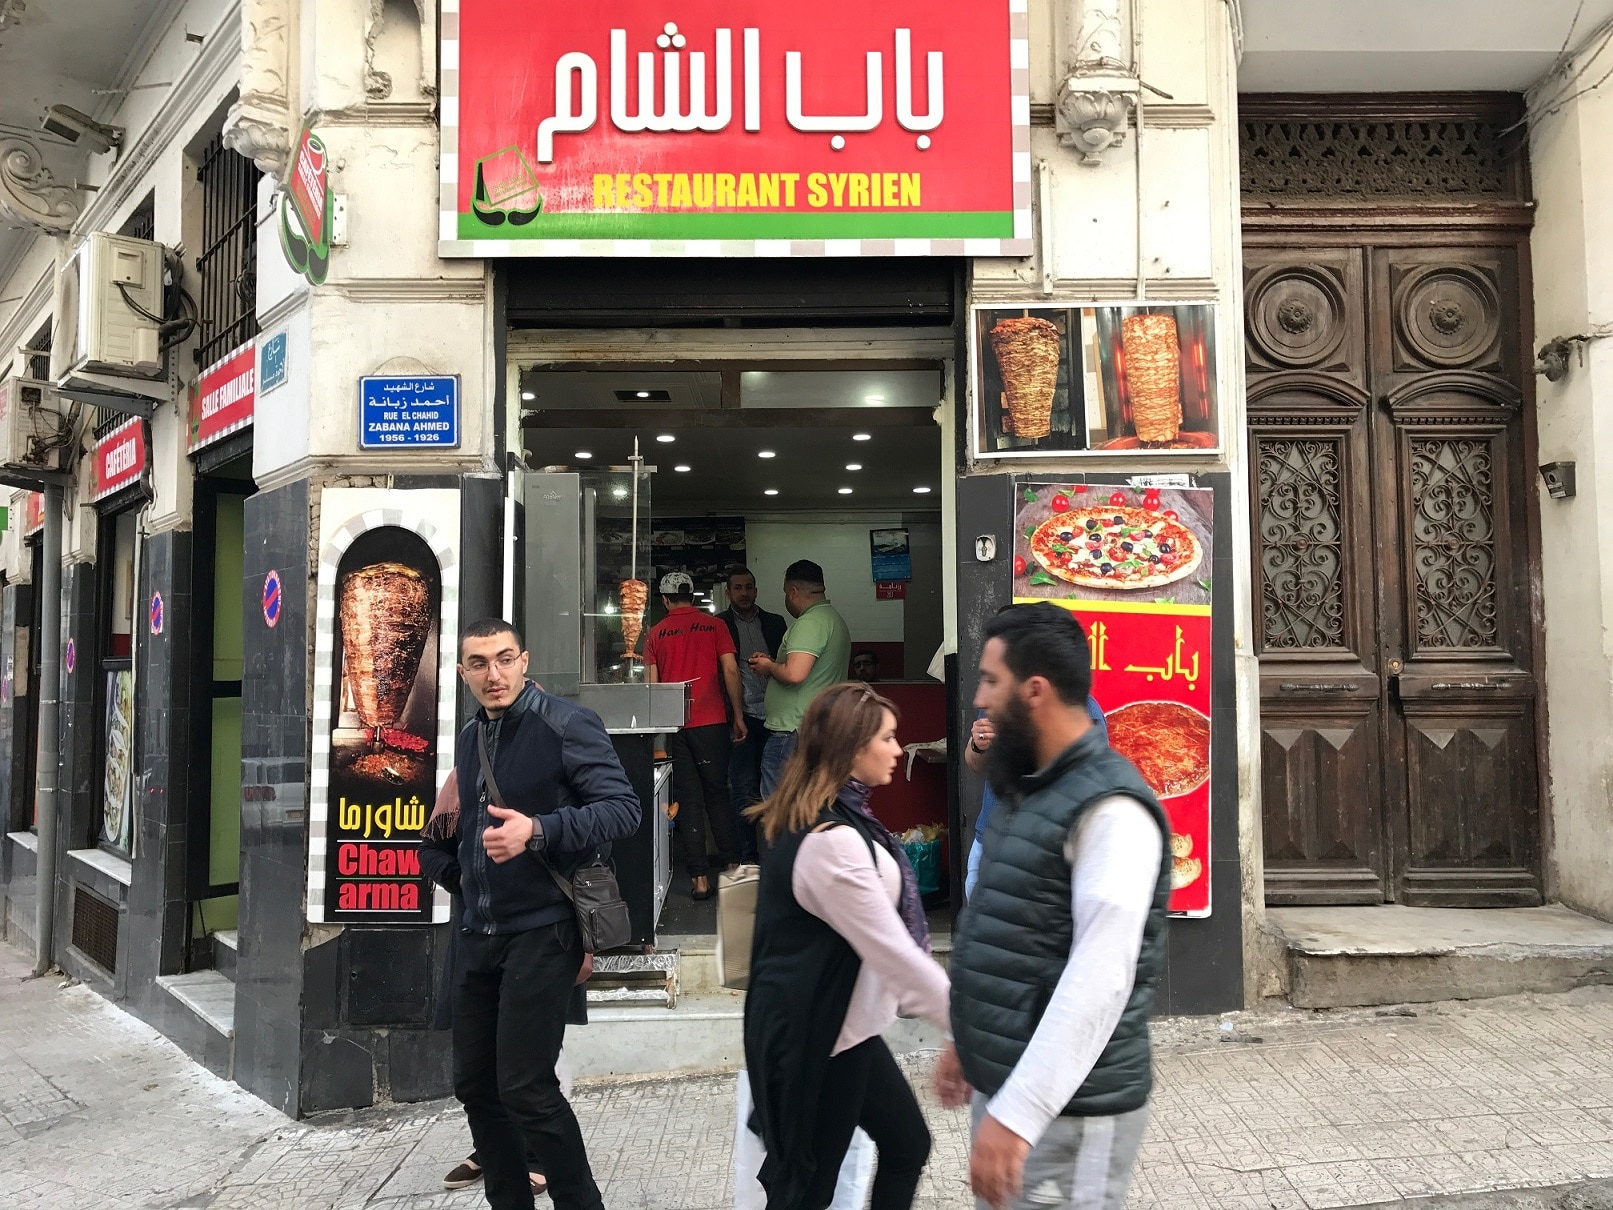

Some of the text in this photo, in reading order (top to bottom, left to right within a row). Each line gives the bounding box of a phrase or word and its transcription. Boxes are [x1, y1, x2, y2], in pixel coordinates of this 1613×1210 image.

[536, 21, 944, 164] باب الشام
[593, 172, 921, 209] RESTAURANT SYRIEN
[202, 388, 219, 420] SALLE
[219, 367, 254, 410] FAMILIALE
[383, 381, 435, 393] شارع الشهيد
[368, 396, 408, 409] زبانة
[383, 411, 439, 420] RUE EL CHAHID
[368, 421, 450, 432] ZABANA AHMED
[379, 434, 405, 442] 1956
[413, 433, 440, 441] 1926
[105, 437, 137, 480] CAFÉTÉRIA
[690, 622, 716, 632] Ham
[1124, 624, 1199, 691] باب
[339, 795, 425, 839] شاورما
[338, 843, 421, 876] Chaw
[338, 882, 419, 910] arma
